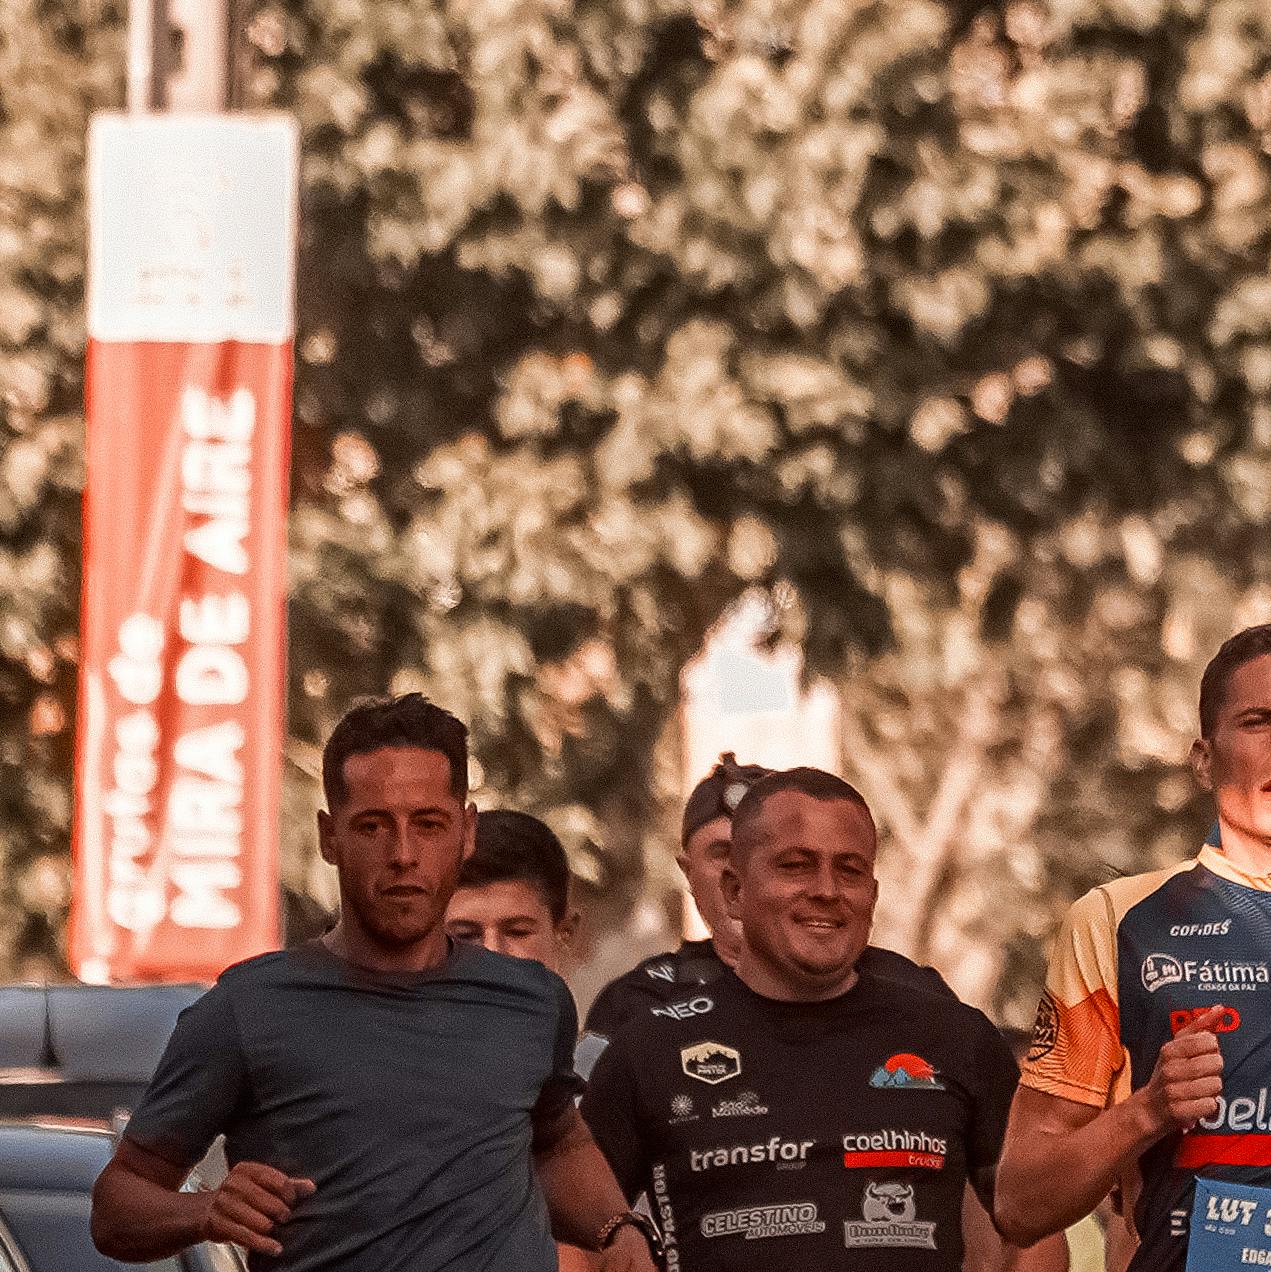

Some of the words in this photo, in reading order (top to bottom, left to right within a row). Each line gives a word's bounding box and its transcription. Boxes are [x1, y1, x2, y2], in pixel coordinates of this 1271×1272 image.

[180, 383, 257, 575] AIRE
[174, 590, 253, 706] DE
[166, 721, 244, 928] MIRA
[1183, 958, 1270, 983] Fátima
[652, 997, 714, 1020] NEO
[690, 1136, 815, 1171] transfor
[843, 1130, 947, 1155] coelhinhos
[704, 1206, 815, 1235] CELESTINO
[1206, 1196, 1258, 1226] LUT
